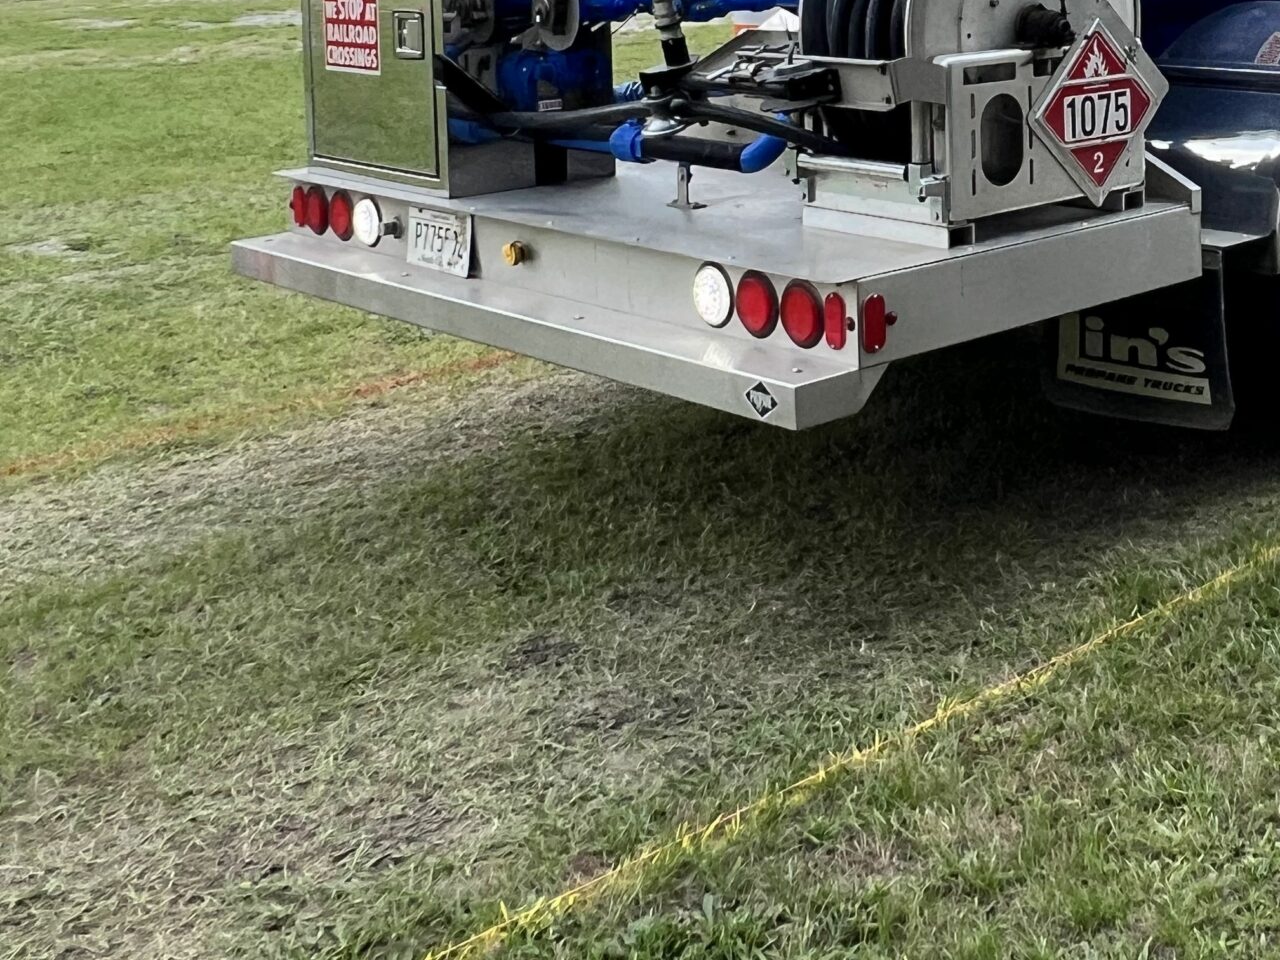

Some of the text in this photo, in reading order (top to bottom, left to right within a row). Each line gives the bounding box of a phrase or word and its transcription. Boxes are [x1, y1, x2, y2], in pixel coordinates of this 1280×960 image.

[325, 1, 337, 18] WE
[365, 3, 377, 21] AT
[327, 23, 377, 44] RAILROAD
[327, 45, 377, 68] CROSSINGS
[1066, 92, 1129, 138] 1075
[1093, 151, 1104, 173] 2
[1065, 364, 1205, 395] PROPANE TRUCKS
